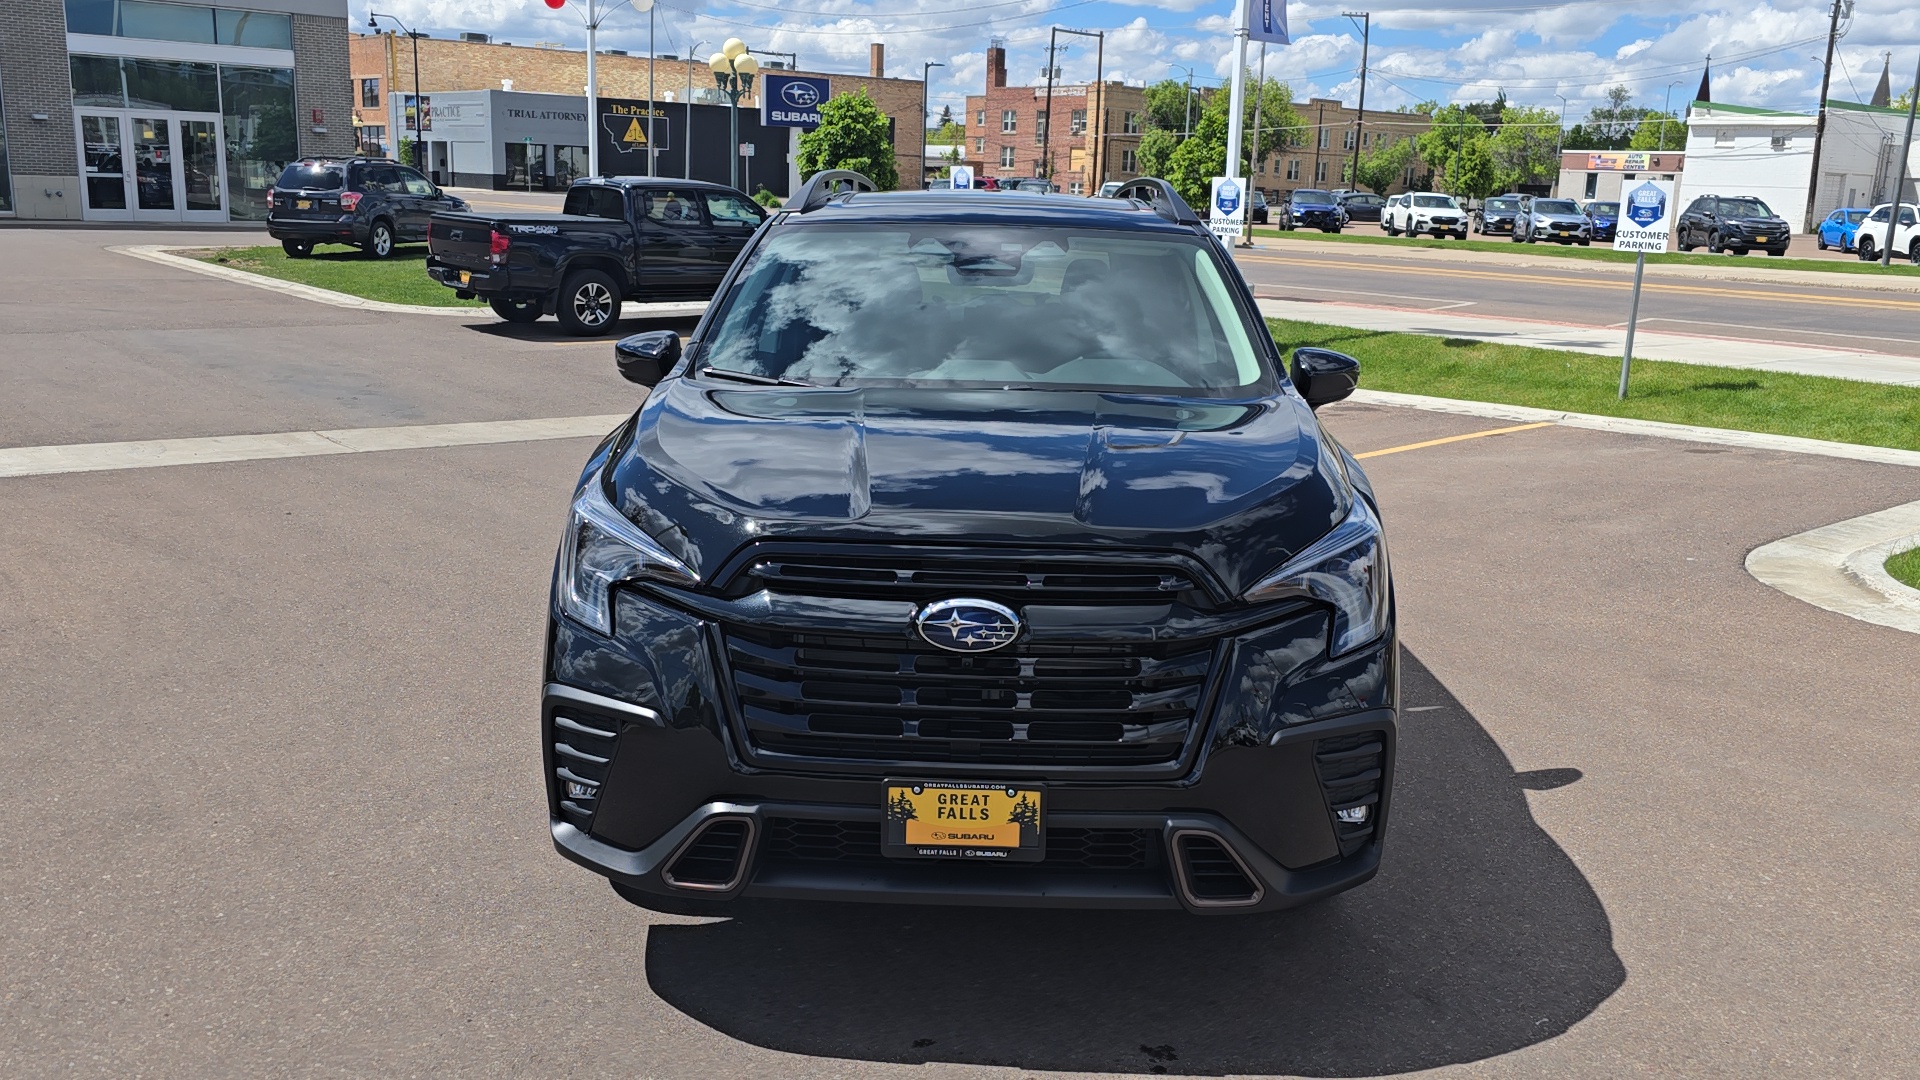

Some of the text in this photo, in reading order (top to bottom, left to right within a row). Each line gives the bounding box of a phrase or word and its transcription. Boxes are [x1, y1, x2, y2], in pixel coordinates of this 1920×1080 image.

[431, 106, 462, 118] PRACTICE
[507, 108, 537, 118] TRIAL
[611, 104, 665, 117] The Pracice
[772, 111, 821, 122] SUBAR
[1212, 226, 1240, 234] PARKING
[1616, 230, 1669, 240] CUSTOMER
[1619, 240, 1662, 251] PARKING
[937, 793, 990, 807] GREAT
[937, 806, 990, 821] FALLS
[975, 850, 1008, 858] SUBARU
